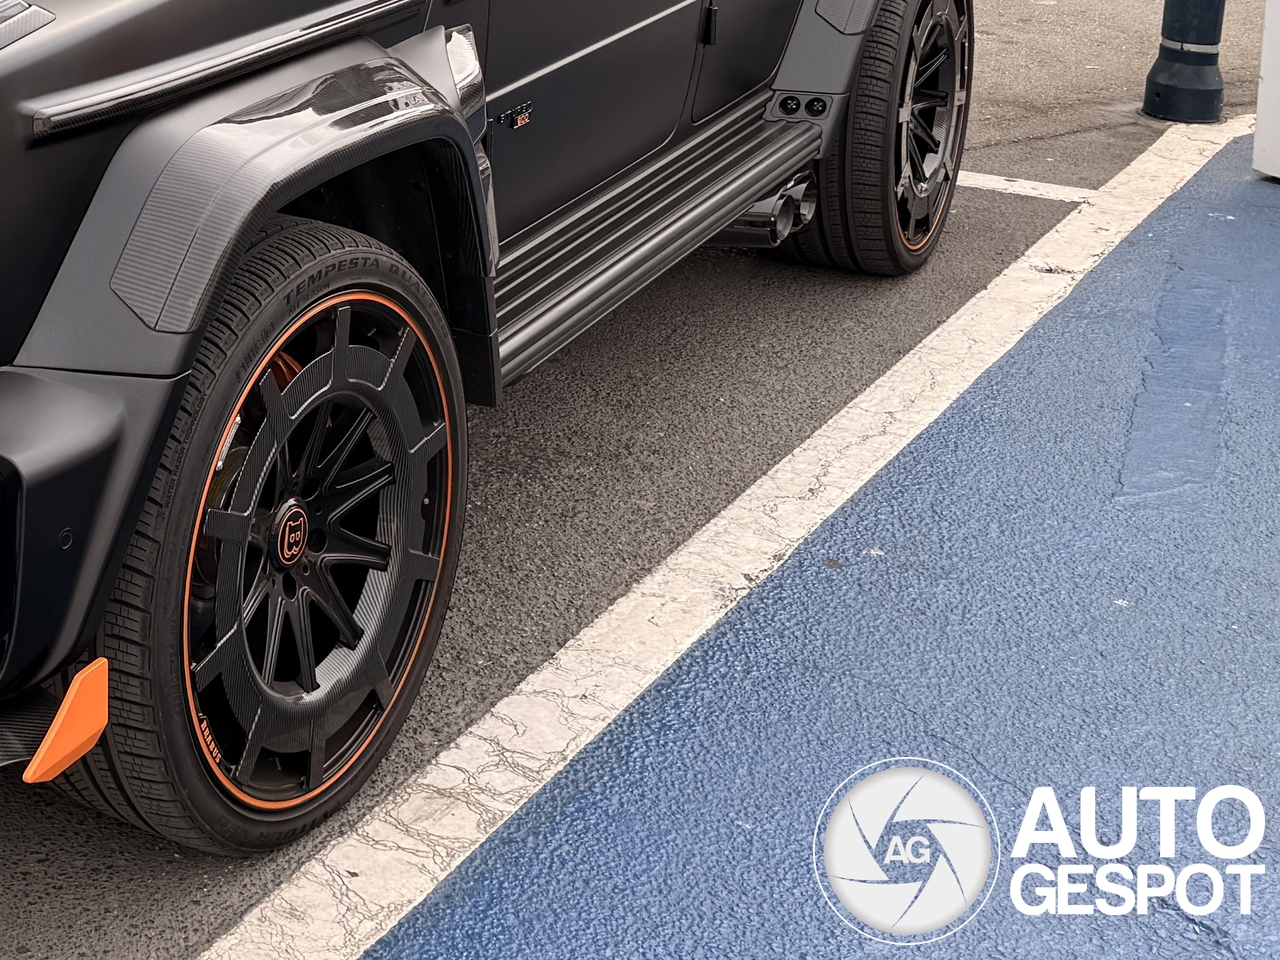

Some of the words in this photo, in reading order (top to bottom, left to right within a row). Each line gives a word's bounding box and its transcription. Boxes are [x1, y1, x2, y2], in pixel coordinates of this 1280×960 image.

[282, 256, 381, 307] TEMPESTA
[172, 445, 187, 480] RAZOR
[200, 719, 223, 764] BRABUS
